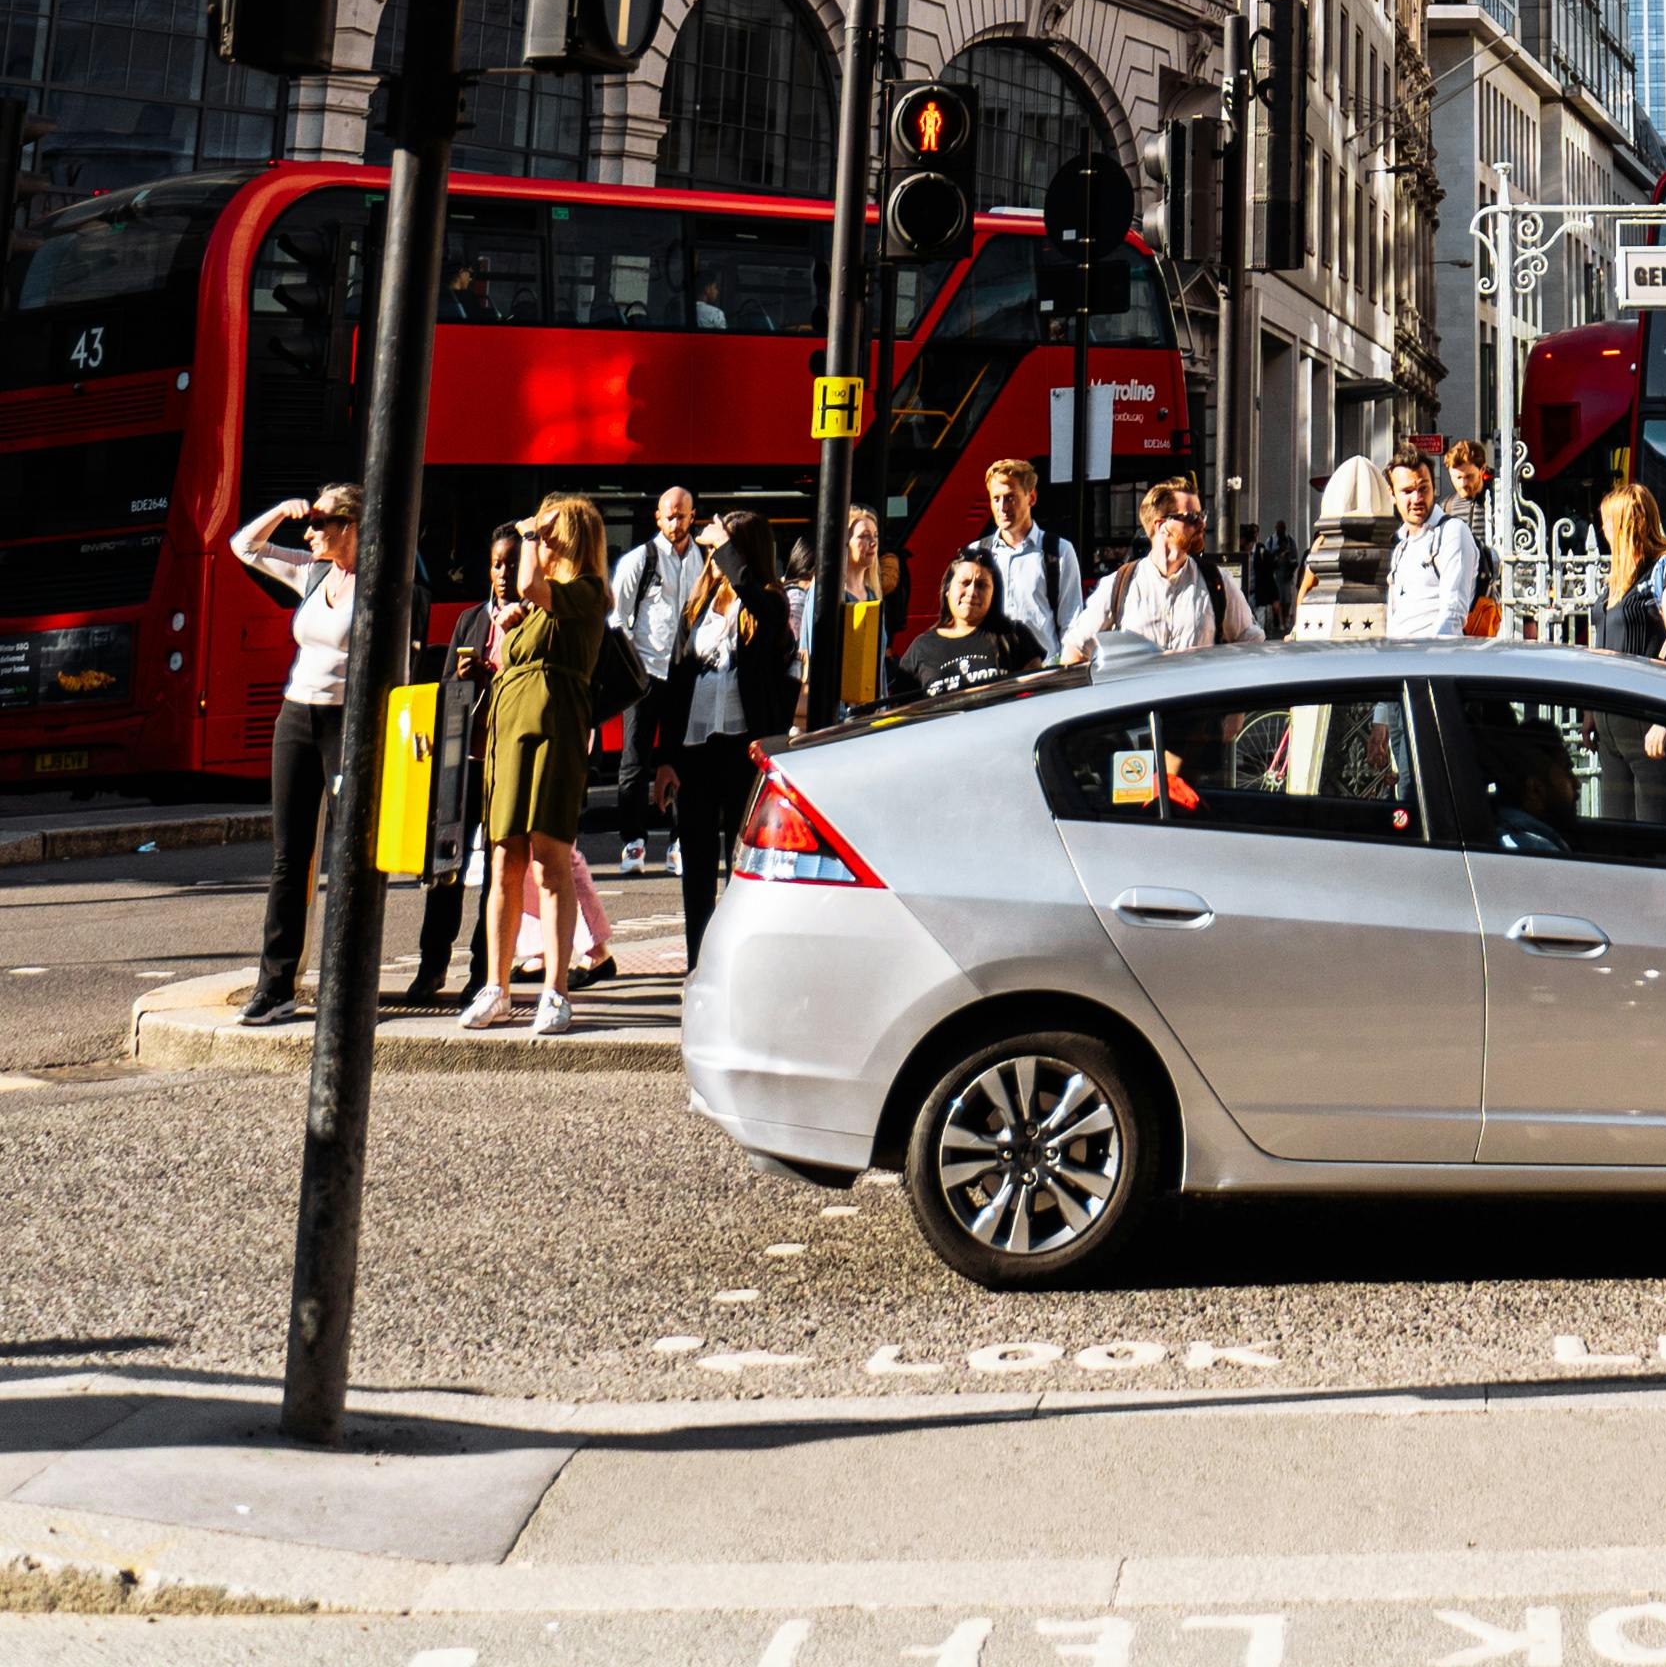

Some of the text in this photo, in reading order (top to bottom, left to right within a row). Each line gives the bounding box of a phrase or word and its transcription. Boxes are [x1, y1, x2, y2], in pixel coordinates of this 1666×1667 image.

[70, 327, 105, 369] 43
[131, 497, 168, 513] BDE2646
[865, 1339, 1283, 1375] LOOK
